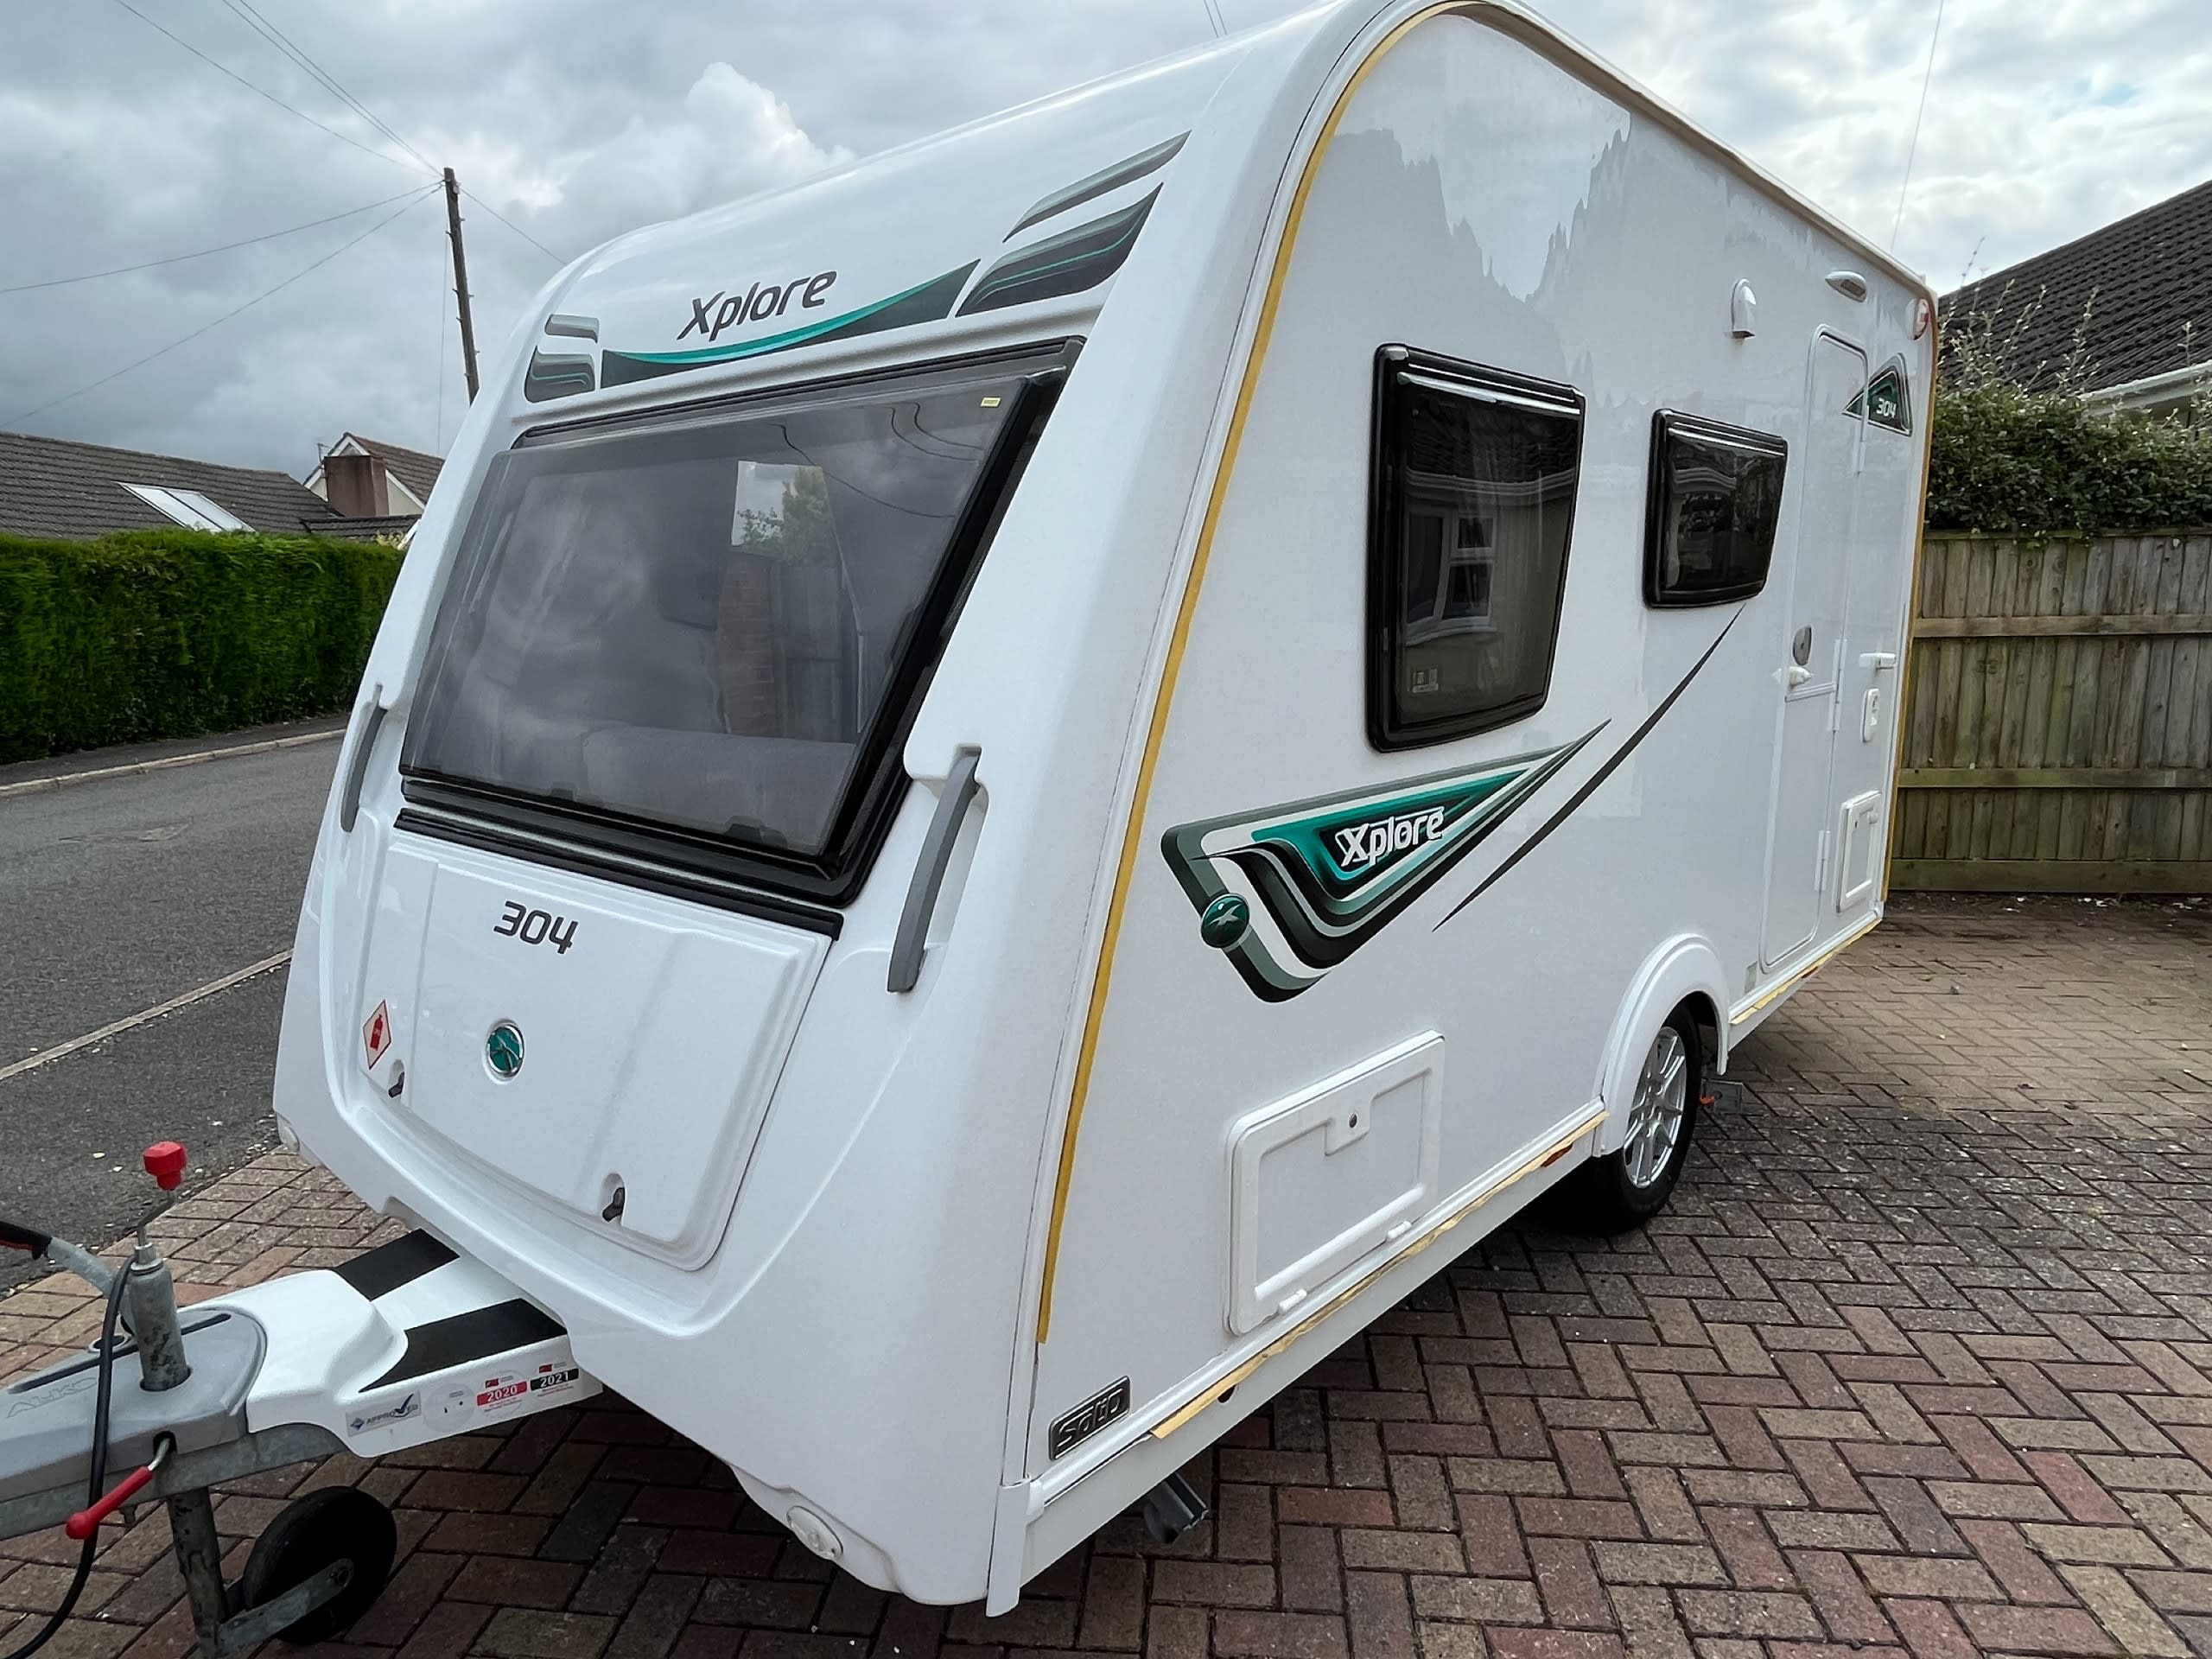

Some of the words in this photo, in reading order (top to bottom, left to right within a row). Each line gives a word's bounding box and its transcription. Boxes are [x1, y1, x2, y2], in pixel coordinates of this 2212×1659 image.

[677, 270, 836, 342] Xplore
[1876, 397, 1897, 418] 304
[1335, 806, 1445, 868] Xplore
[493, 900, 578, 955] 304
[486, 1384, 518, 1402] 2020
[540, 1371, 569, 1388] 2021
